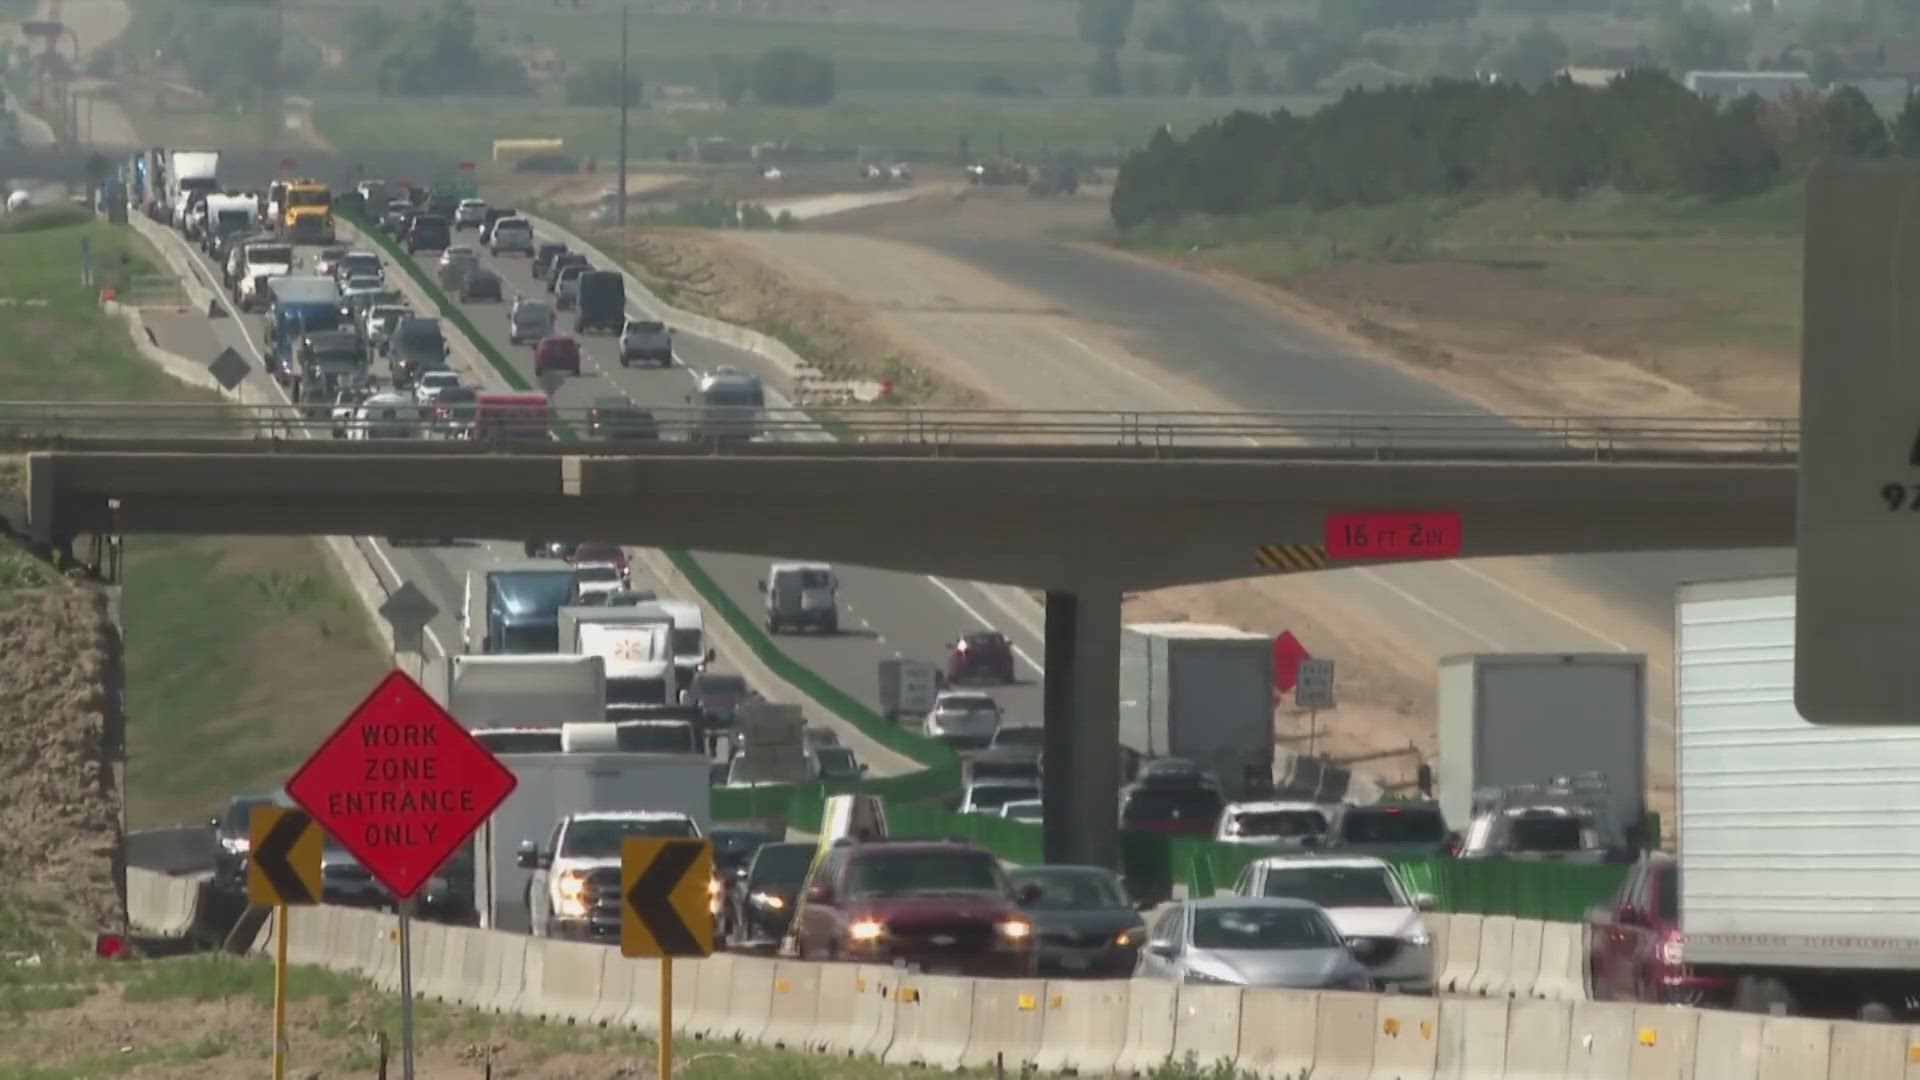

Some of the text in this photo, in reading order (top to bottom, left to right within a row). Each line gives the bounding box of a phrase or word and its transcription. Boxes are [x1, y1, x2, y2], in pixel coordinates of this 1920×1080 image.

[1345, 523, 1369, 547] 16
[1377, 529, 1396, 547] FT
[361, 724, 437, 747] WORK
[365, 758, 436, 780] ZONE
[328, 790, 473, 815] ENTRANCE
[365, 823, 438, 847] ONLY
